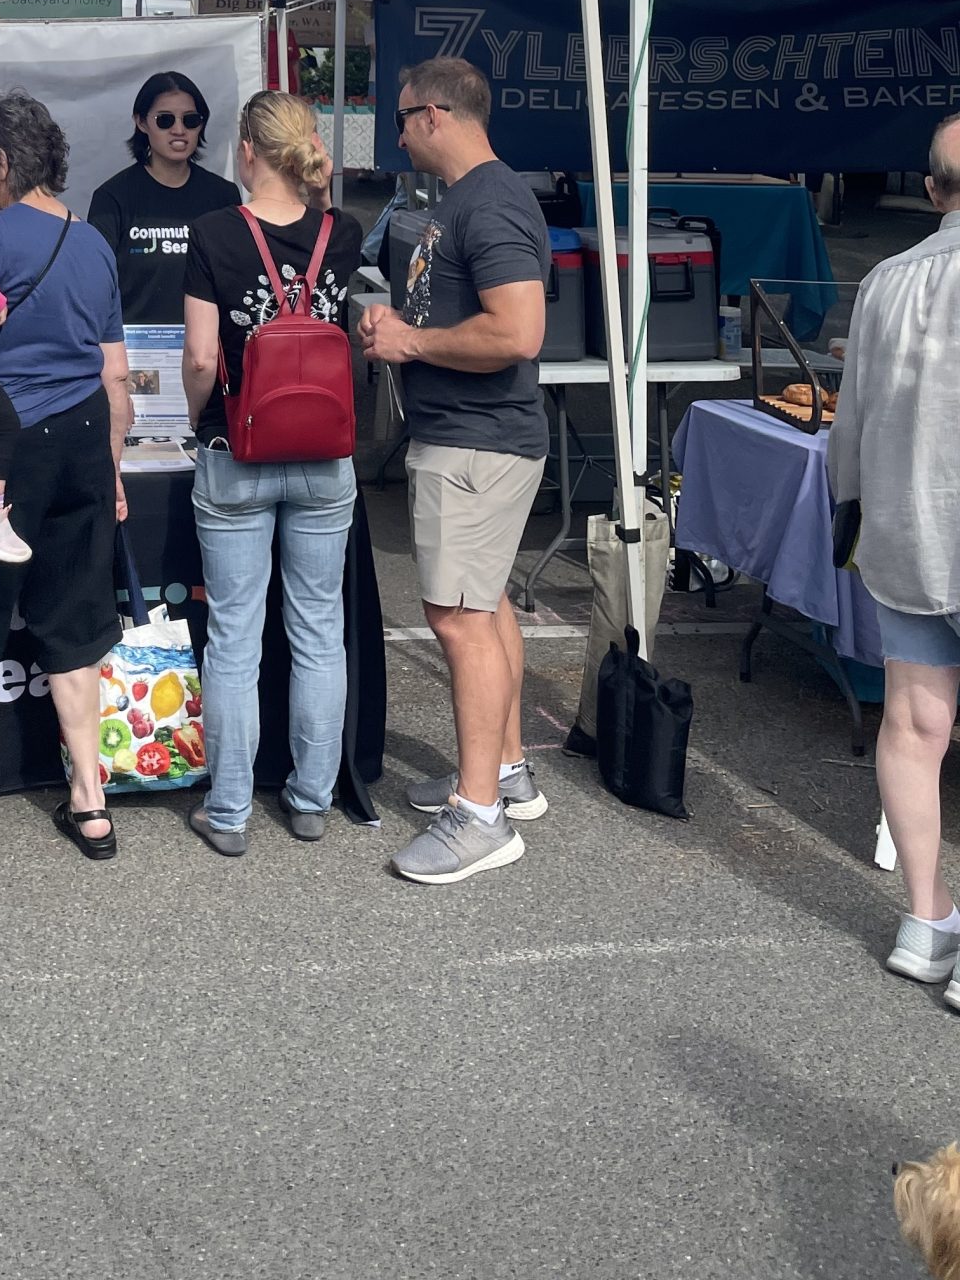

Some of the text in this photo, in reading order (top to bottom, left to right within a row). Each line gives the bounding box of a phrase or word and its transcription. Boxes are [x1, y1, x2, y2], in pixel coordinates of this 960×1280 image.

[500, 87, 780, 111] DELIAESSEN
[795, 82, 829, 112] &
[129, 224, 190, 240] Commut
